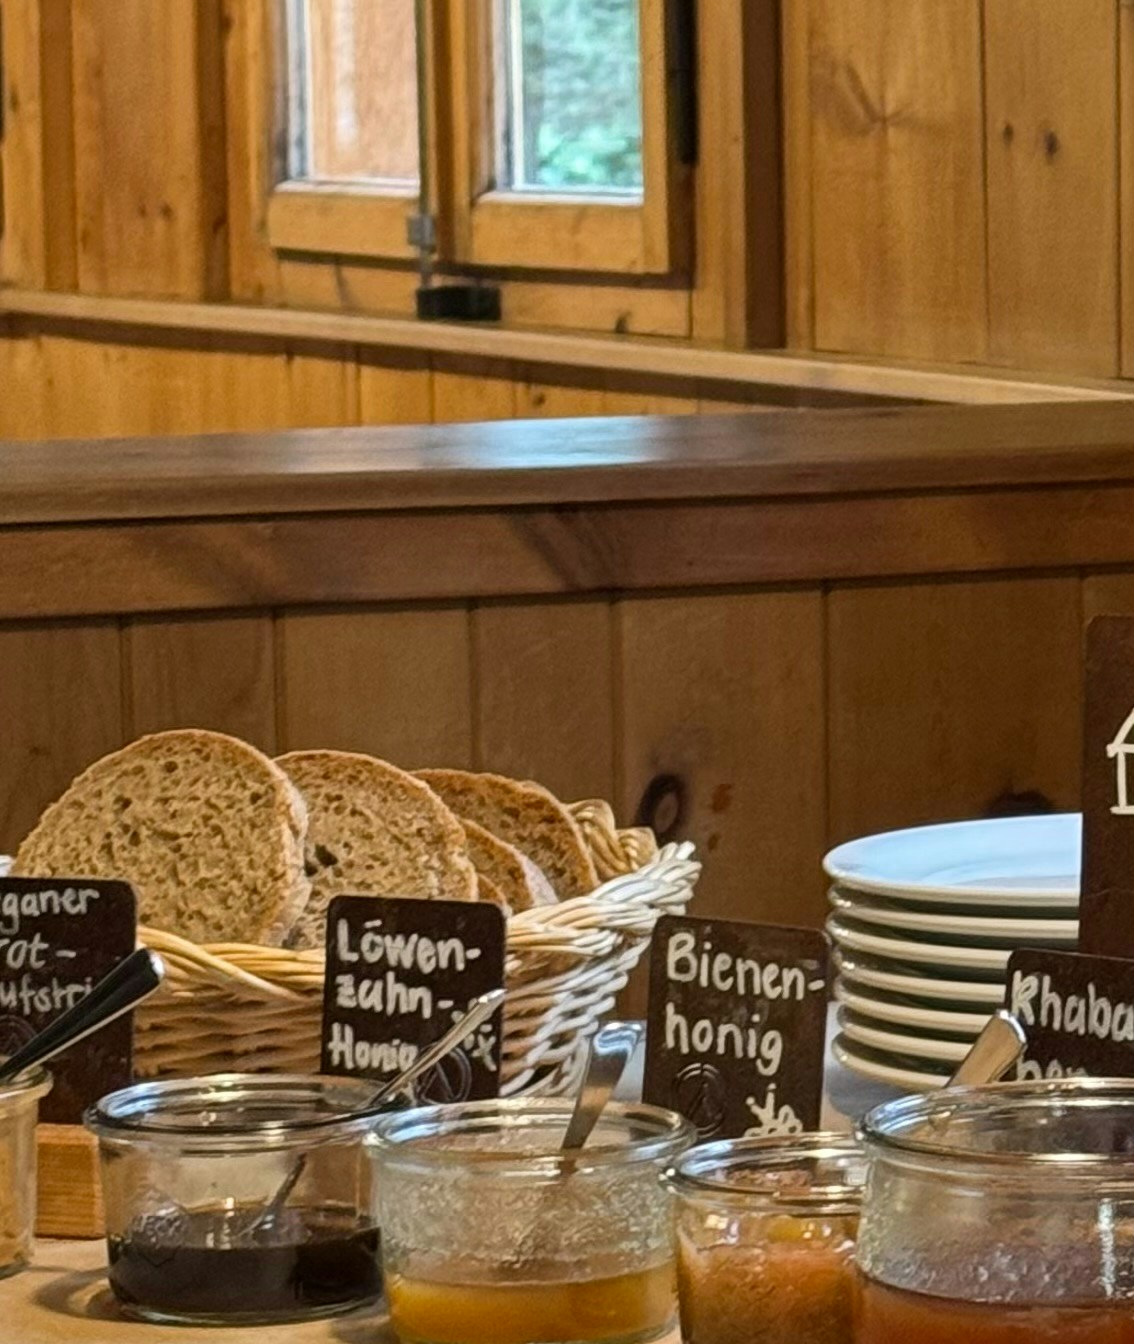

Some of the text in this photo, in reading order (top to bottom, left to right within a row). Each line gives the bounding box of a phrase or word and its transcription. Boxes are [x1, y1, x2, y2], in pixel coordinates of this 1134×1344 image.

[0, 887, 100, 935] ganer
[667, 932, 825, 1000] Bienen-
[665, 1002, 783, 1076] honig
